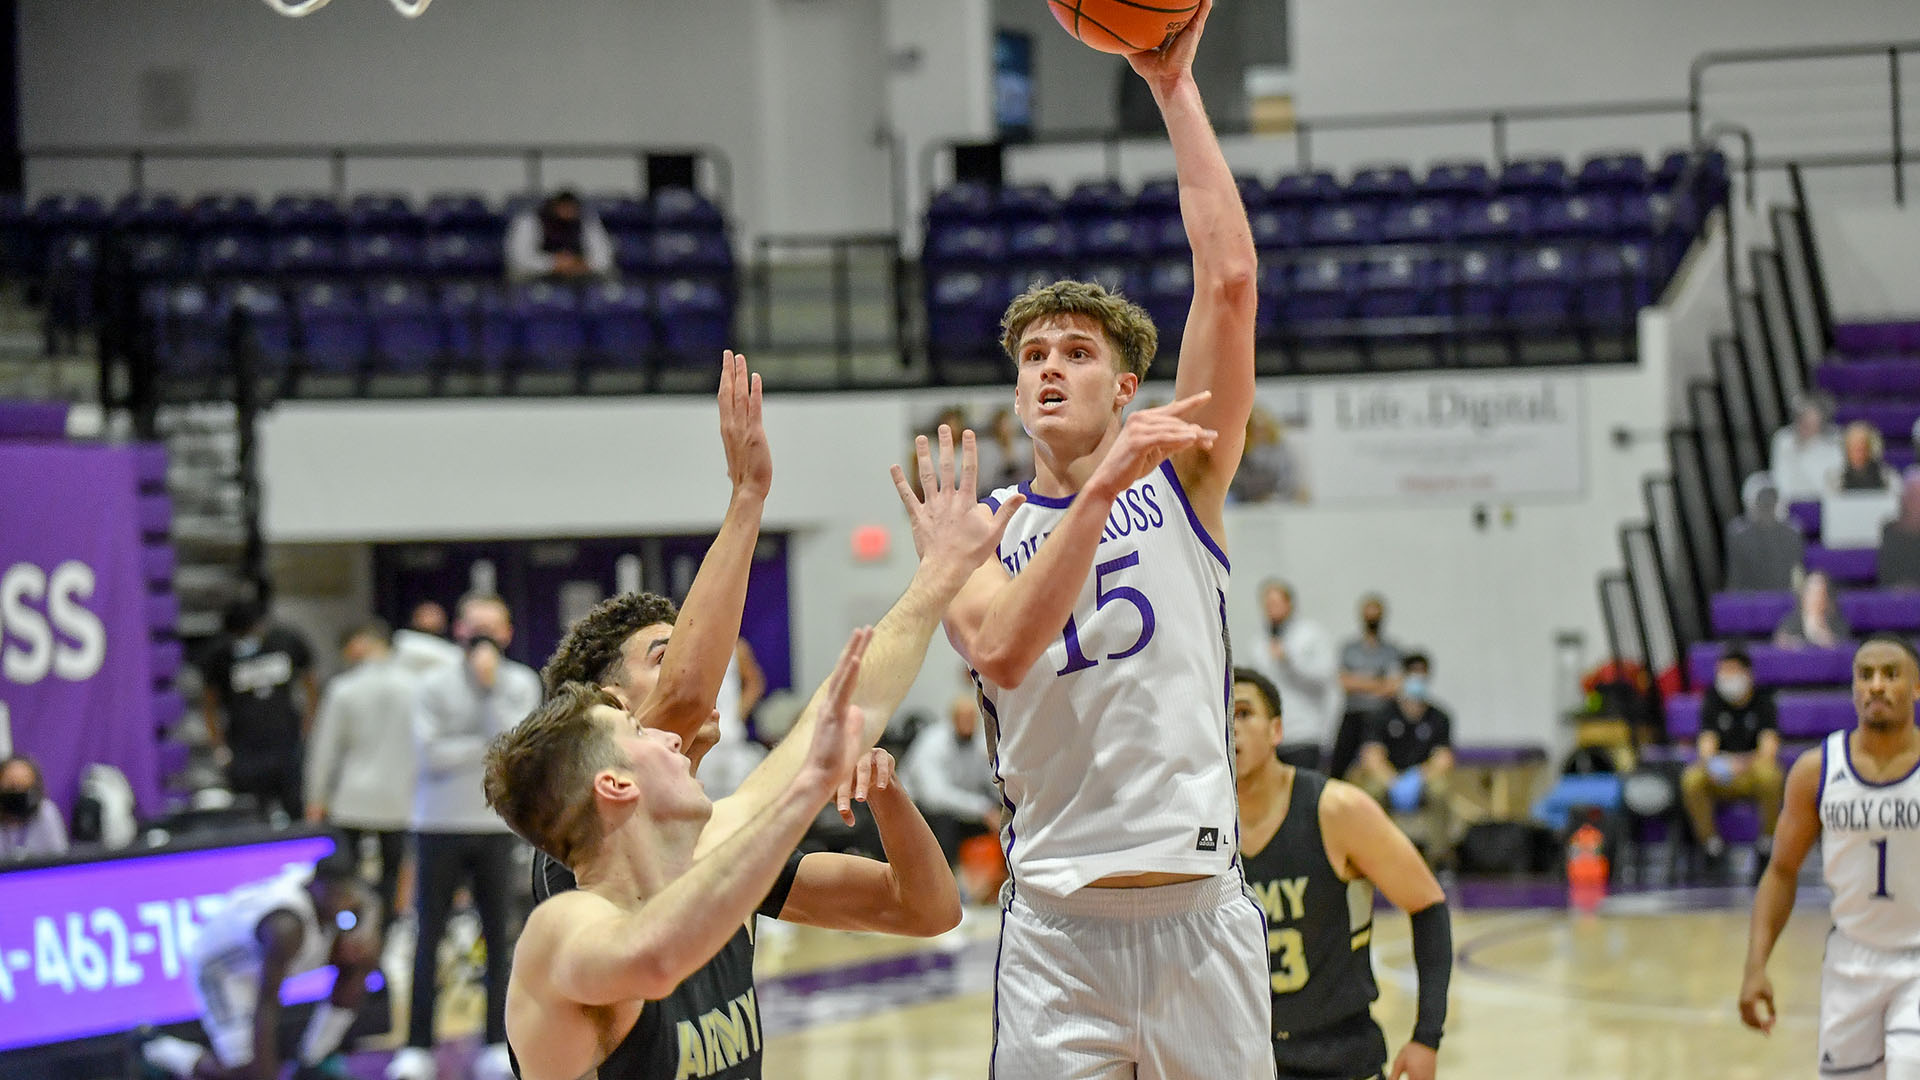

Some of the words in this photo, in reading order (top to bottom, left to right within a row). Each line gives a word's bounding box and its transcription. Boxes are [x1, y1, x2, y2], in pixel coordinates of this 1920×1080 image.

[1098, 483, 1164, 545] OSS
[0, 559, 107, 685] SS
[1055, 550, 1156, 677] 15
[1823, 799, 1874, 832] HOLY
[1251, 876, 1309, 922] MY
[1869, 836, 1894, 900] 1
[674, 985, 761, 1080] ARMY
